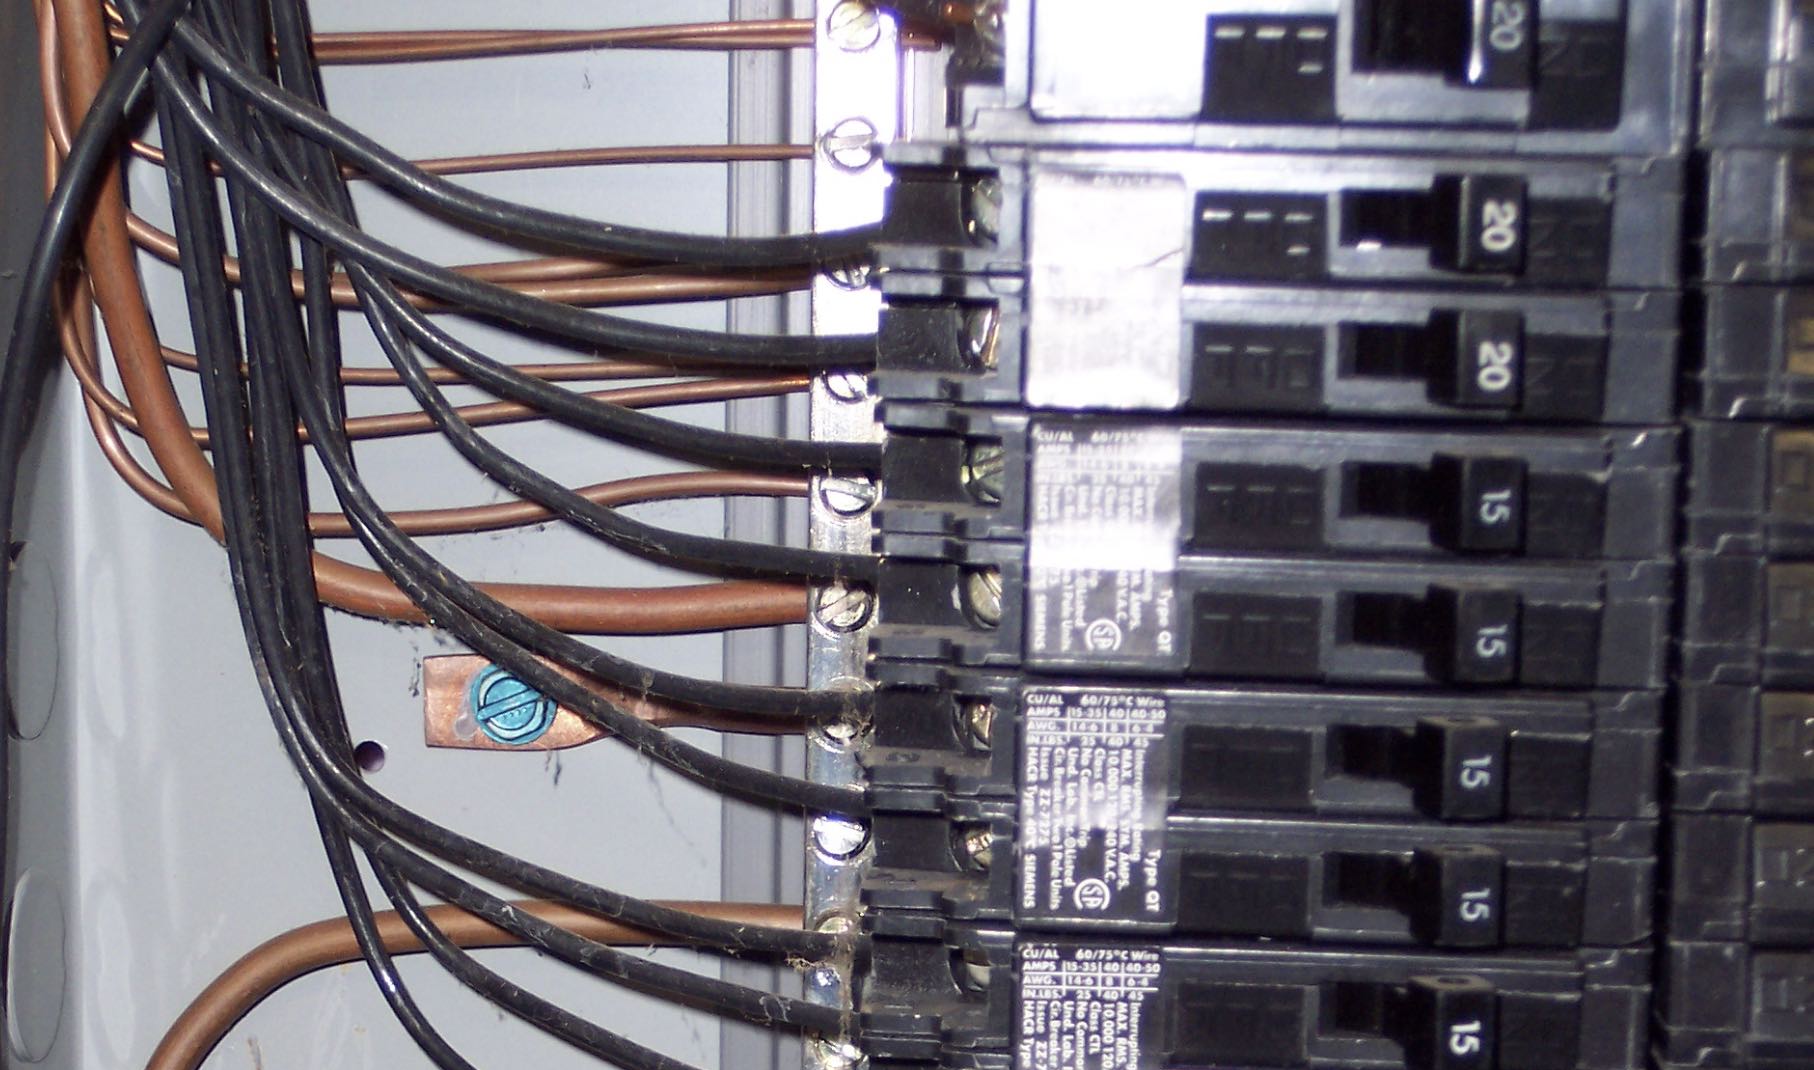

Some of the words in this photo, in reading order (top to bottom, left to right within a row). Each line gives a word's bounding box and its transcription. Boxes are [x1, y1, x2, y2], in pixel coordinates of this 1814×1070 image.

[1490, 0, 1524, 50] 20
[1482, 201, 1516, 251] 20
[1478, 341, 1513, 391] 20
[1480, 489, 1511, 524] 15
[1476, 625, 1507, 658] 15
[1460, 755, 1492, 789] 15
[1460, 888, 1490, 921] 15
[1449, 1020, 1481, 1055] 15
